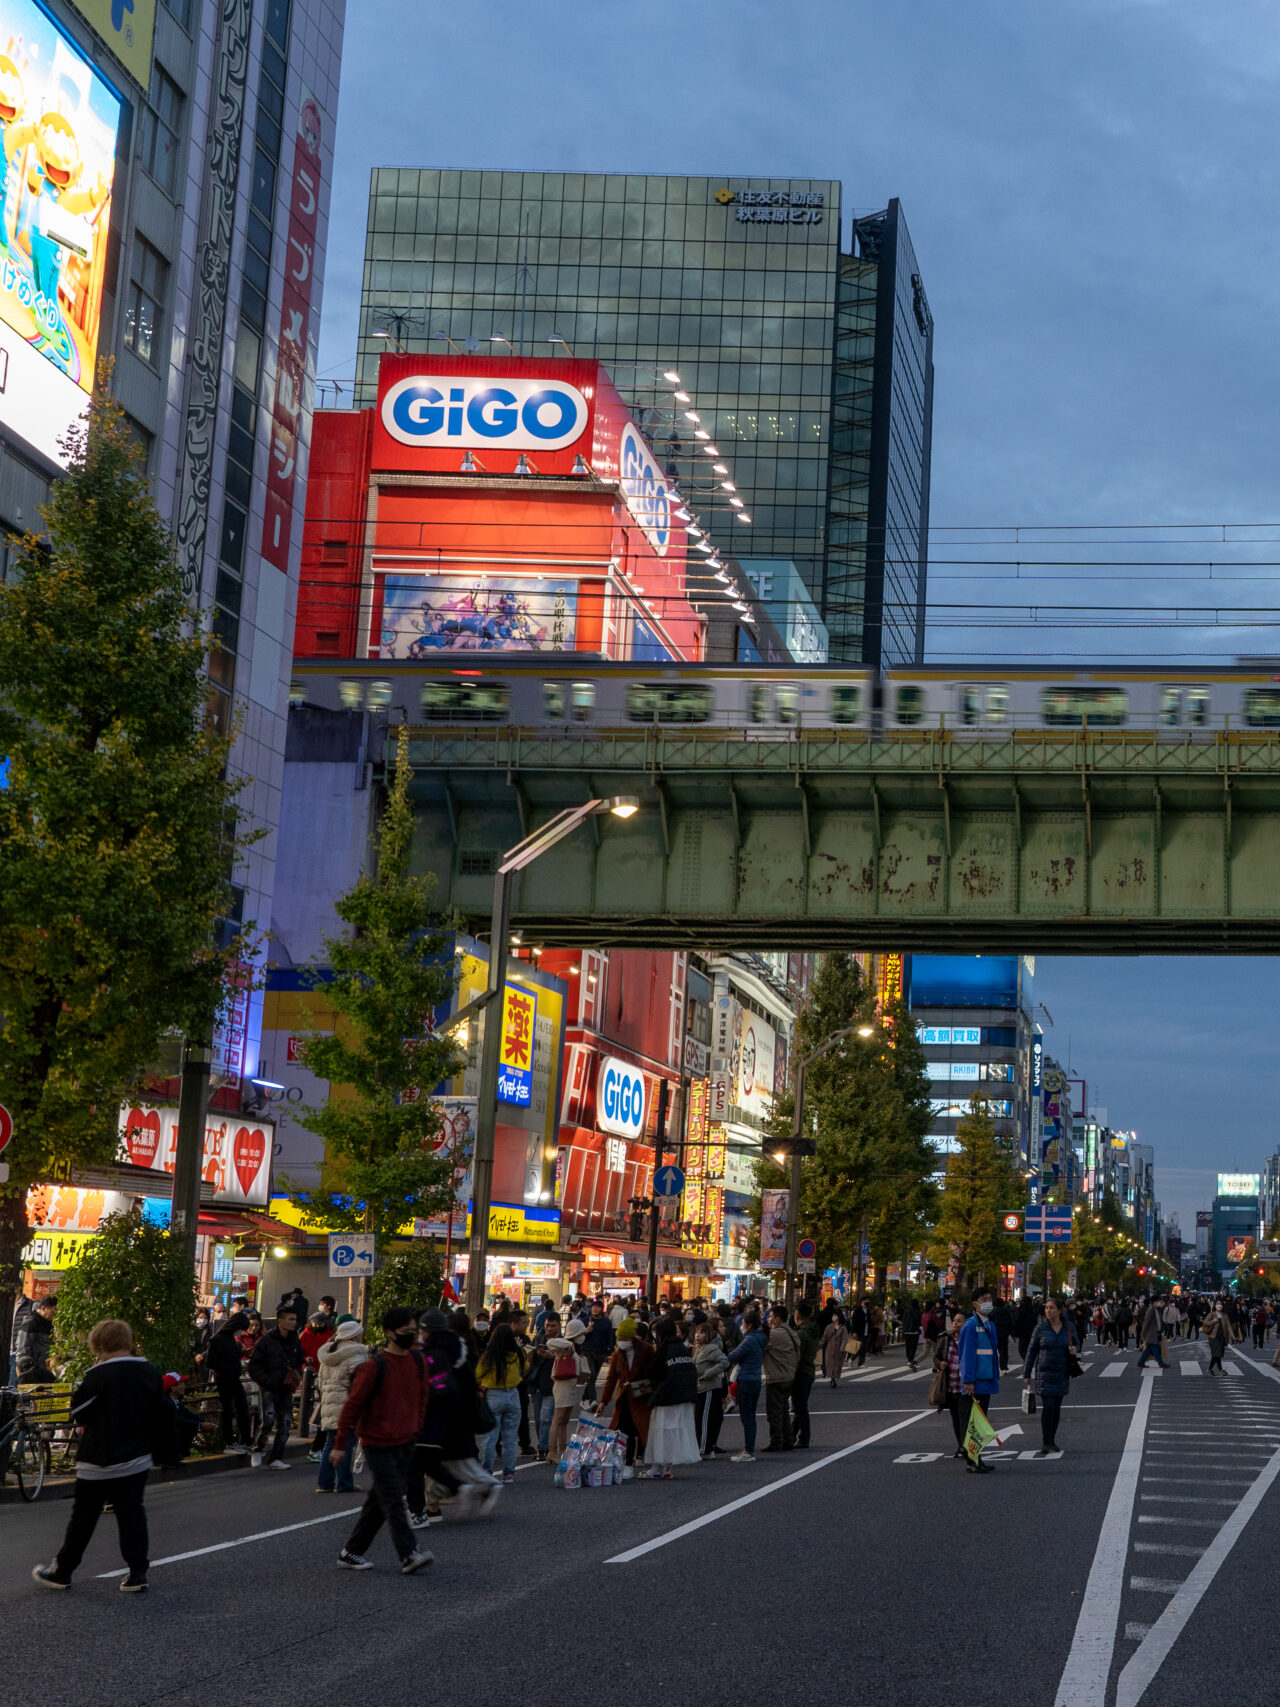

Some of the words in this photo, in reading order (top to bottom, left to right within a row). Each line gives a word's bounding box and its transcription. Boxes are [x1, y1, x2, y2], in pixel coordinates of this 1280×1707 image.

[738, 188, 823, 207] 住友不動産
[737, 207, 822, 224] 秋葉原ビル
[272, 168, 317, 548] ラブメルシー
[393, 386, 578, 440] GiGO
[623, 434, 669, 546] GiGO
[505, 993, 531, 1065] 薬
[924, 1029, 980, 1043] 高額買取
[953, 1065, 977, 1075] AKIBA
[604, 1068, 643, 1128] GiGO
[716, 1079, 726, 1111] GPS
[1006, 1217, 1018, 1227] 50
[337, 1249, 347, 1264] P
